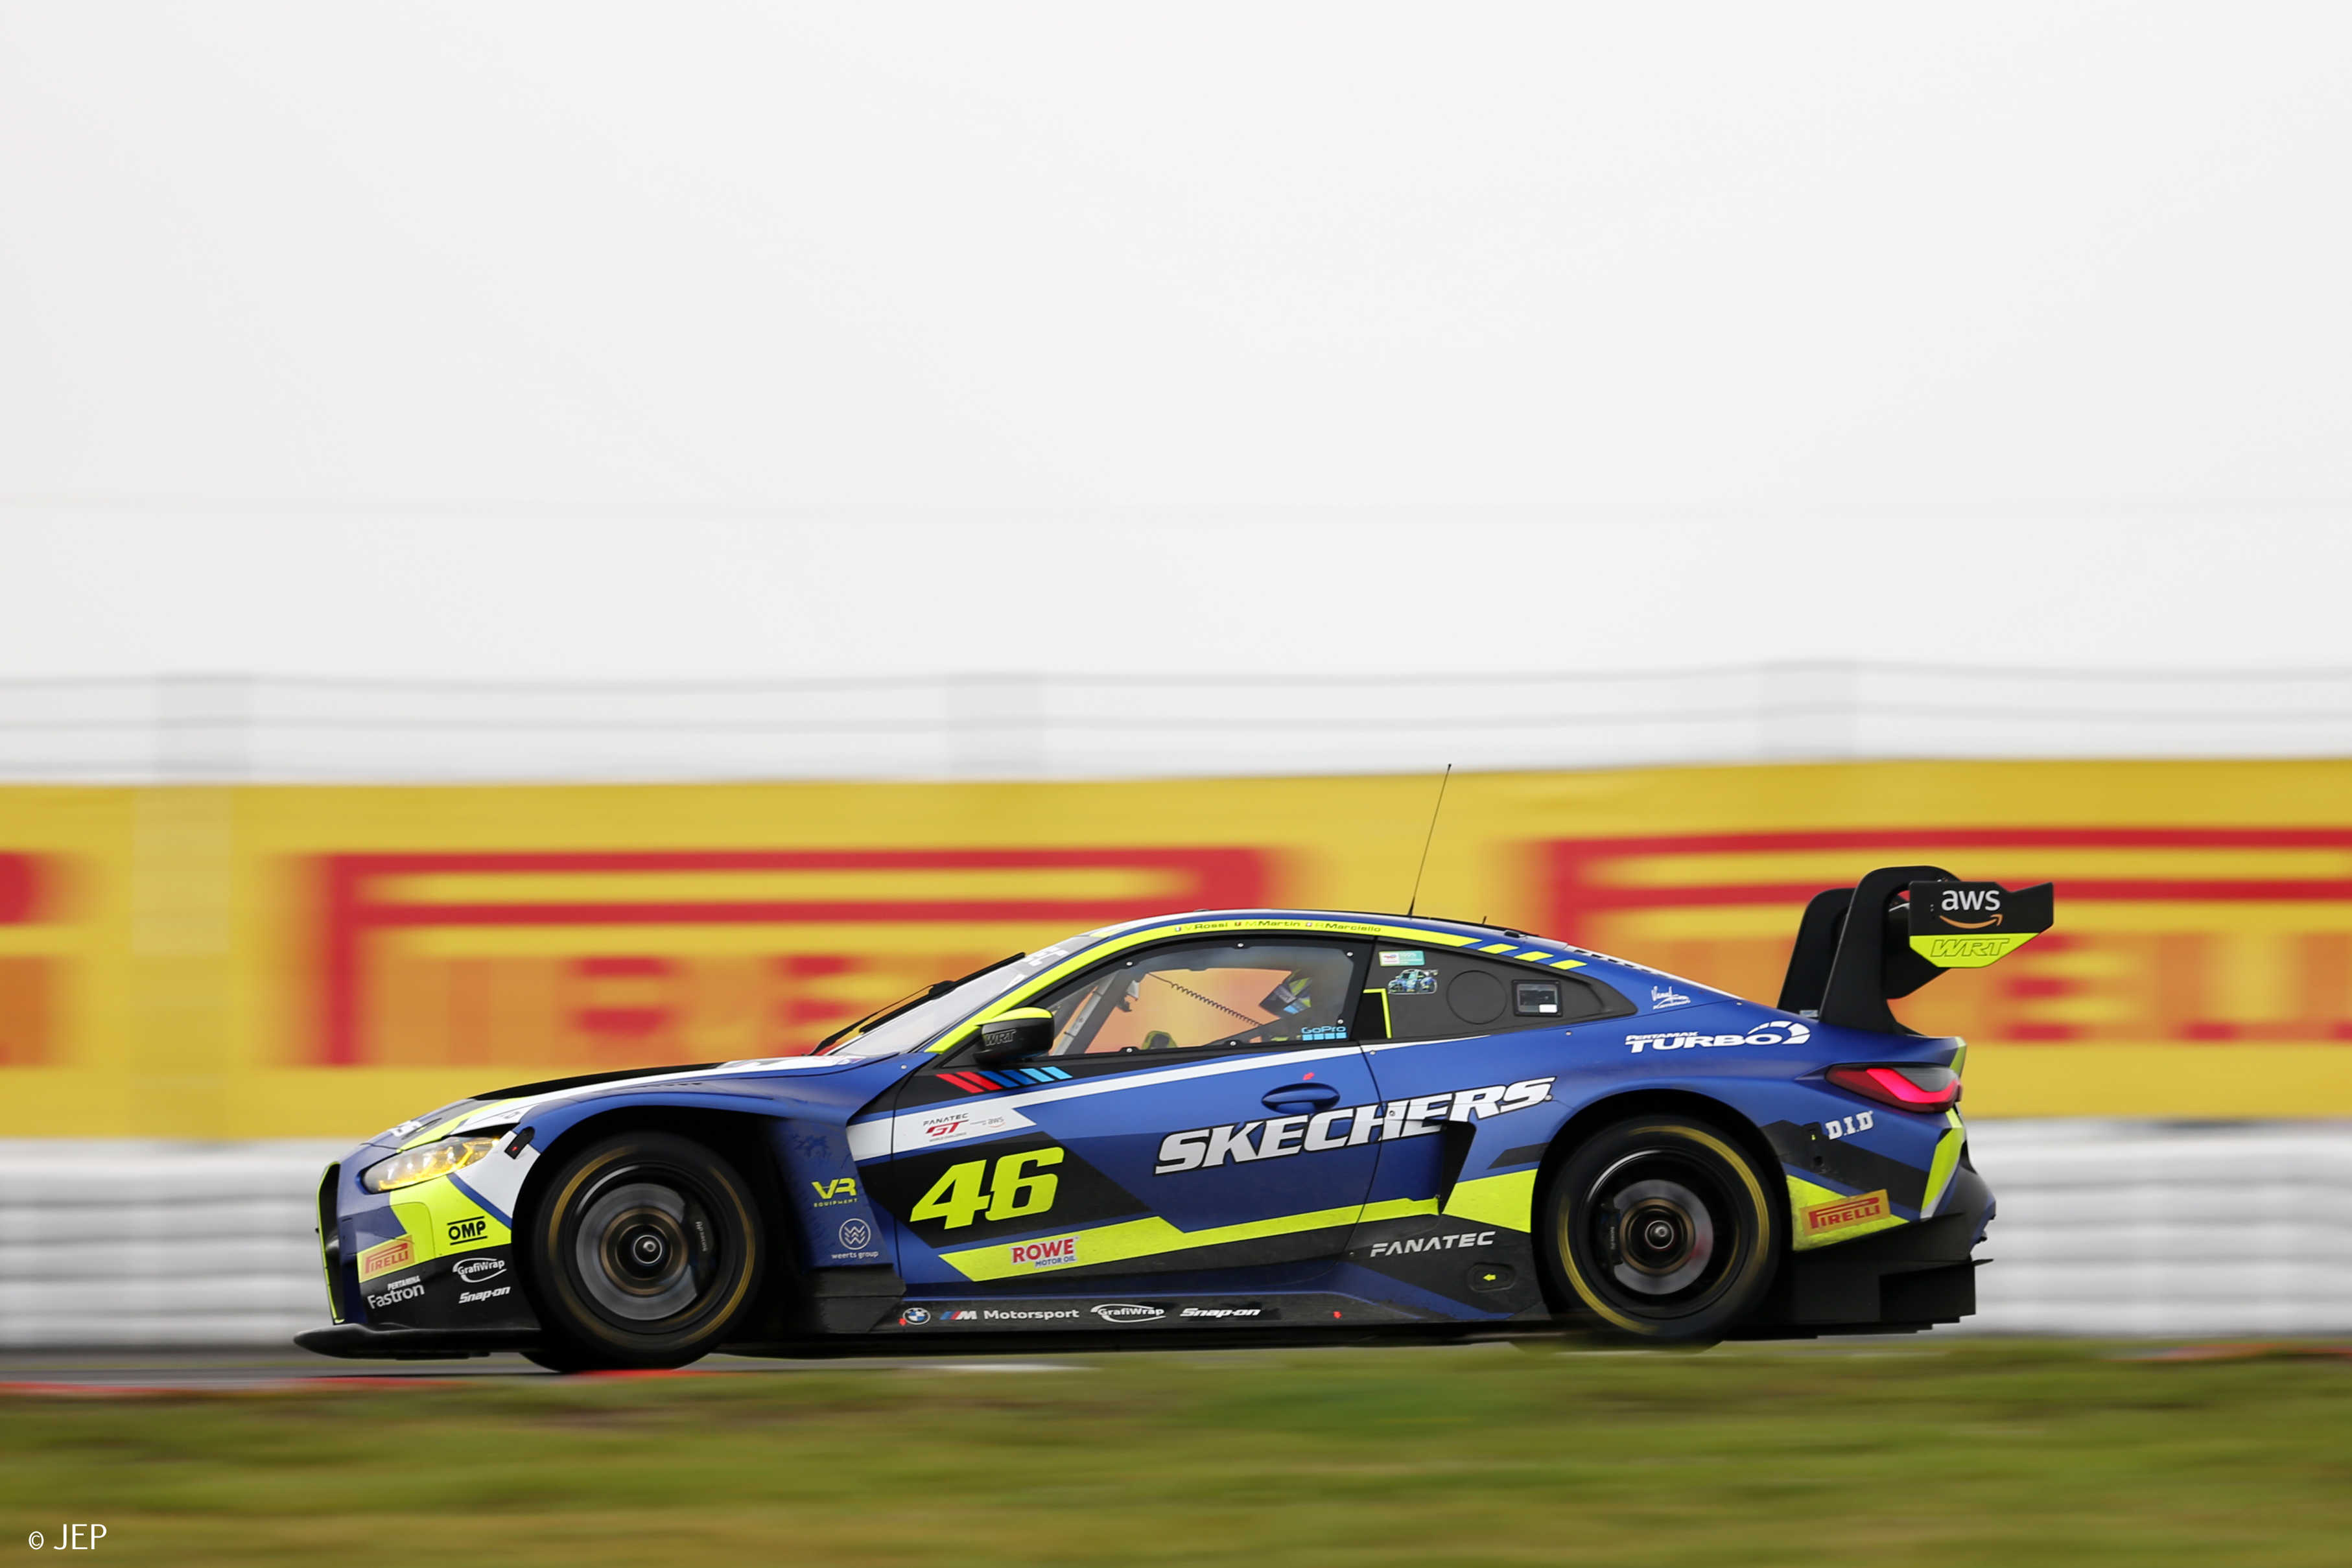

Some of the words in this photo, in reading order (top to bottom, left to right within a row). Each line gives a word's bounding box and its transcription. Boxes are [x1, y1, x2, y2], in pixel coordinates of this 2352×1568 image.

[1941, 890, 2001, 911] aws
[1930, 938, 2010, 957] WRT
[1301, 1025, 1347, 1034] GoPro
[1626, 1031, 1699, 1041] PERTAMAX
[1625, 1033, 1783, 1053] TURBO
[923, 1113, 969, 1126] FANATEC
[1155, 1076, 1556, 1175] SKECHERS
[910, 1147, 1065, 1230] 46
[814, 1198, 858, 1208] EQUIPMENT
[1809, 1197, 1880, 1229] PIRELLI
[449, 1221, 486, 1241] OMP
[1012, 1238, 1074, 1263] ROWE
[1370, 1231, 1496, 1258] FANATEC
[365, 1243, 409, 1274] PIRELLI
[858, 1251, 879, 1259] group
[1035, 1258, 1062, 1267] MOTOR
[458, 1260, 505, 1276] GrafiWrap
[367, 1284, 425, 1309] Fastron
[458, 1286, 511, 1304] Snap-on
[983, 1309, 1079, 1320] Motorsport
[1098, 1307, 1165, 1318] GrafiWrap
[1180, 1307, 1261, 1318] Snap-on
